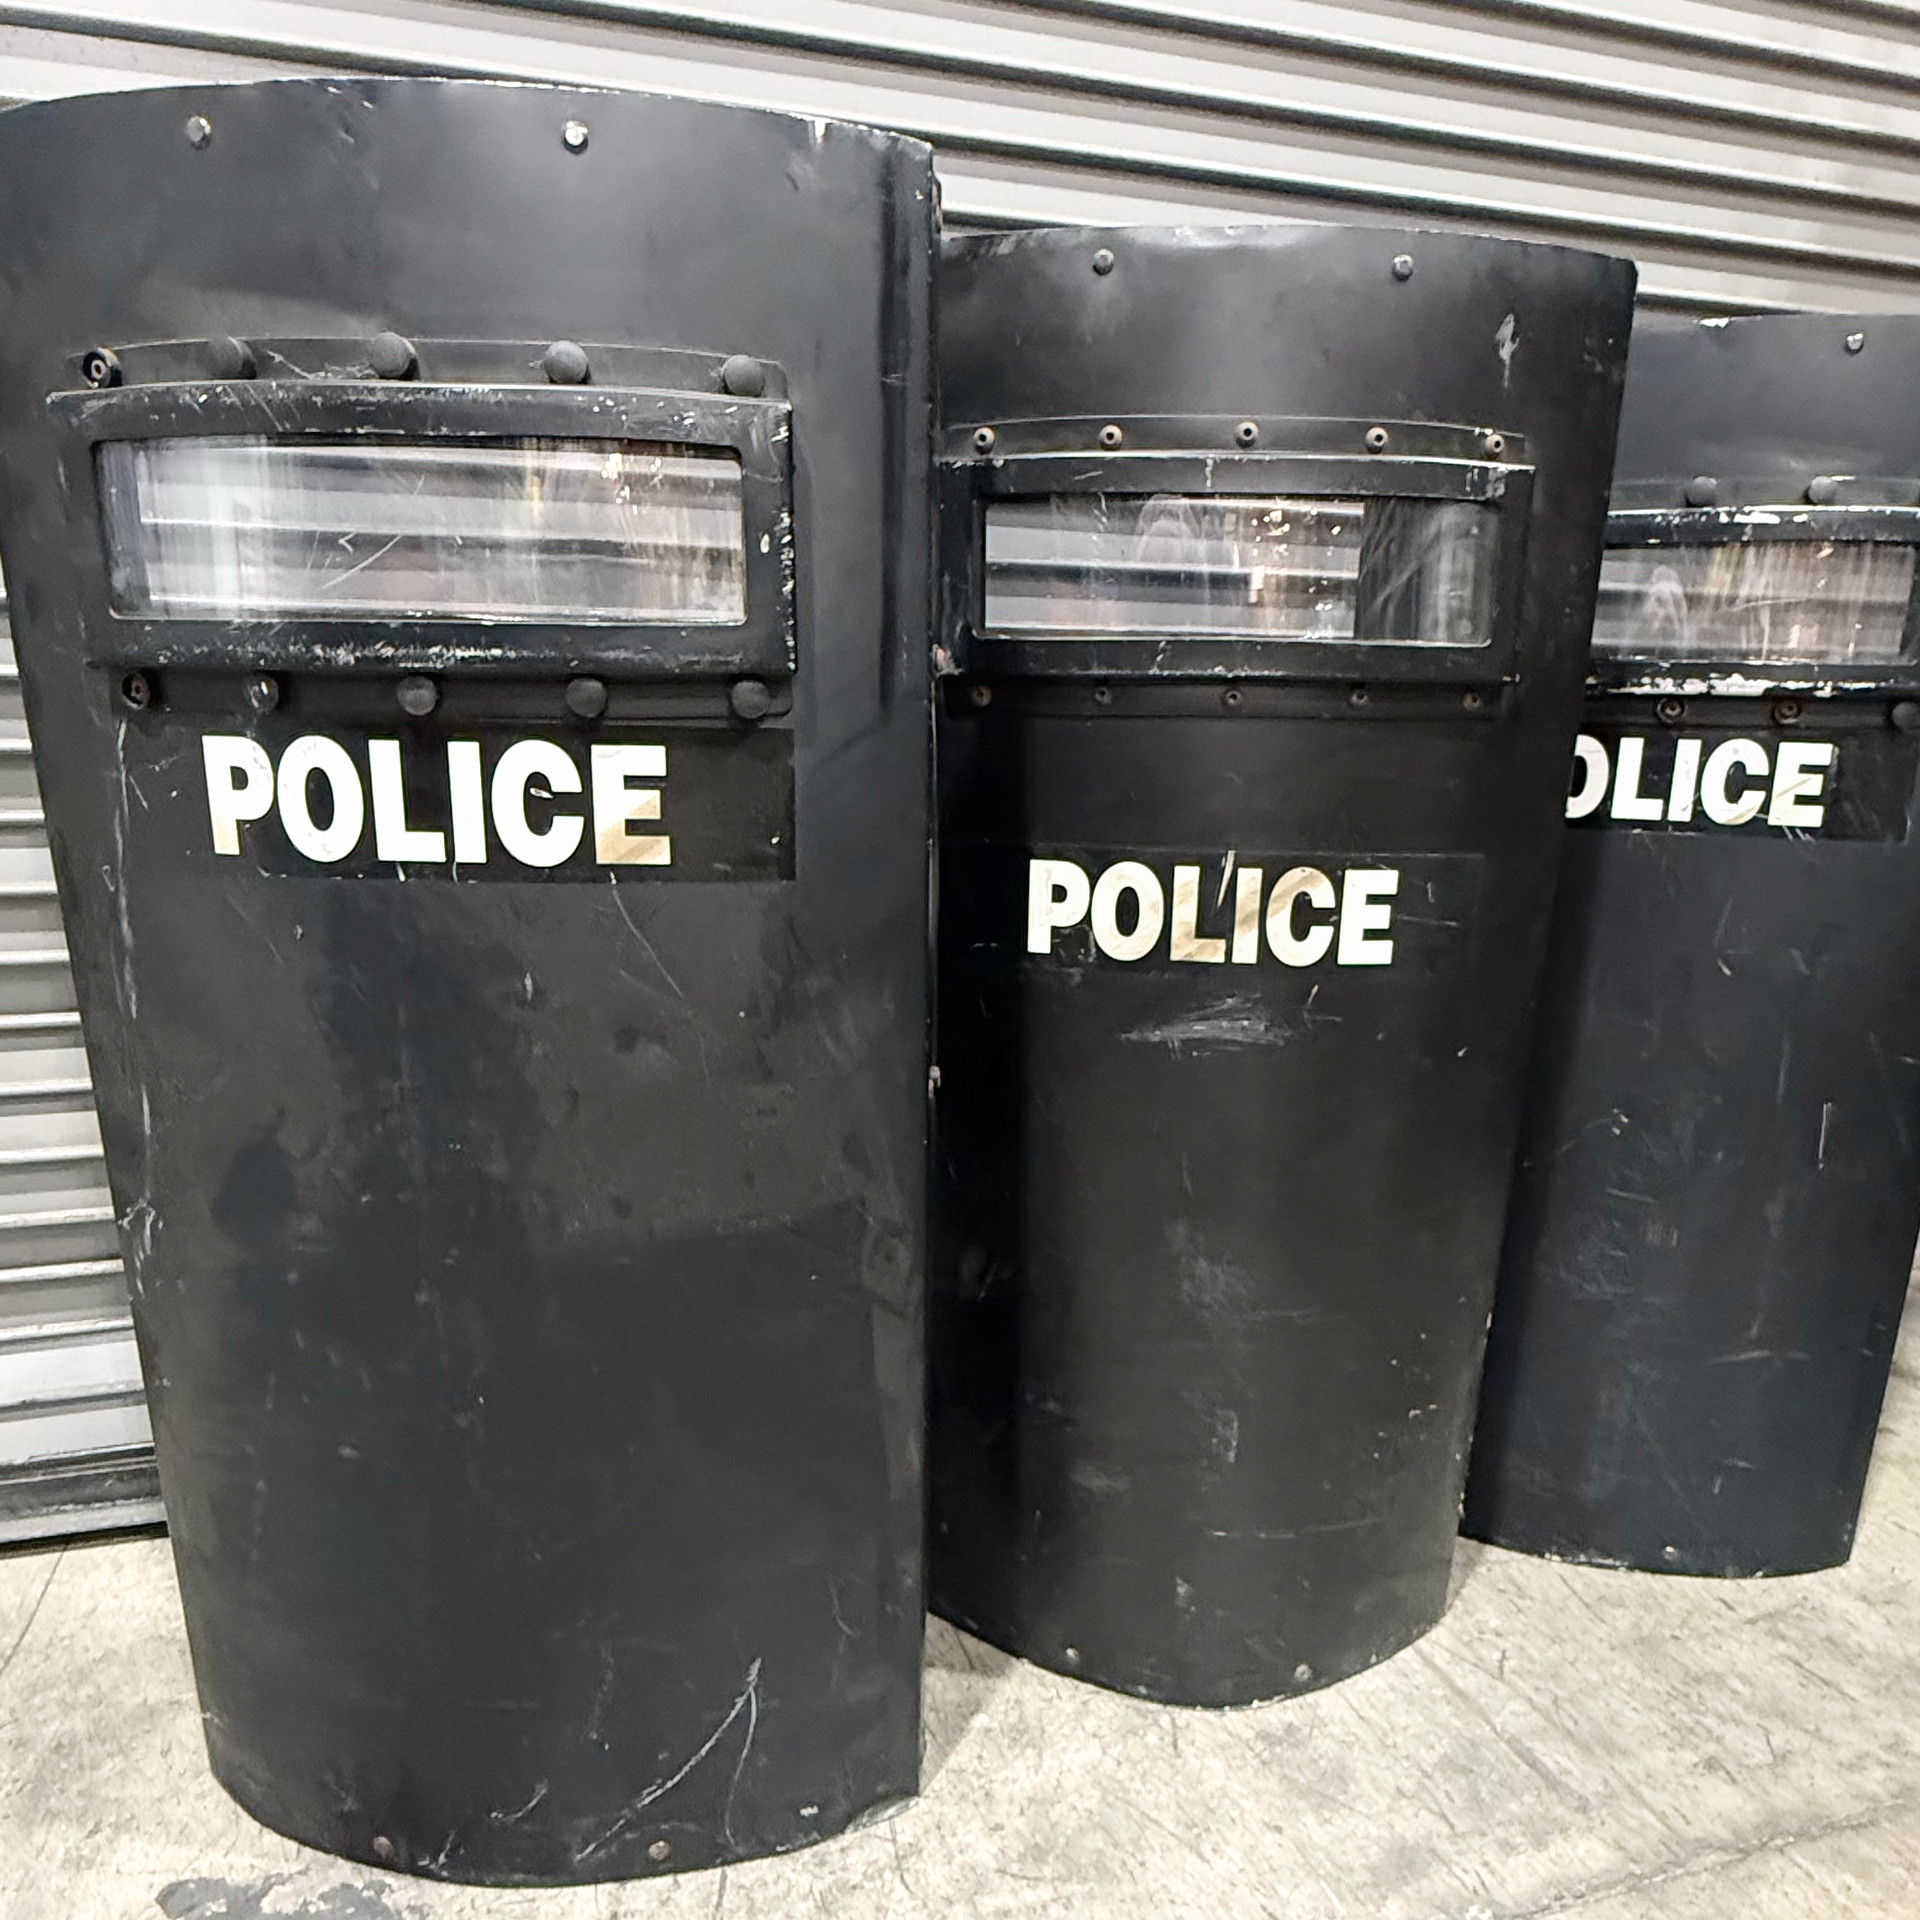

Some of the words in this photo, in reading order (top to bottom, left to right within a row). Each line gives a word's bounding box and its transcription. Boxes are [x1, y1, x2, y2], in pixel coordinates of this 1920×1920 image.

[201, 733, 673, 869] POLICE
[1564, 733, 1834, 829] OLICE
[1026, 857, 1400, 968] POLICE
